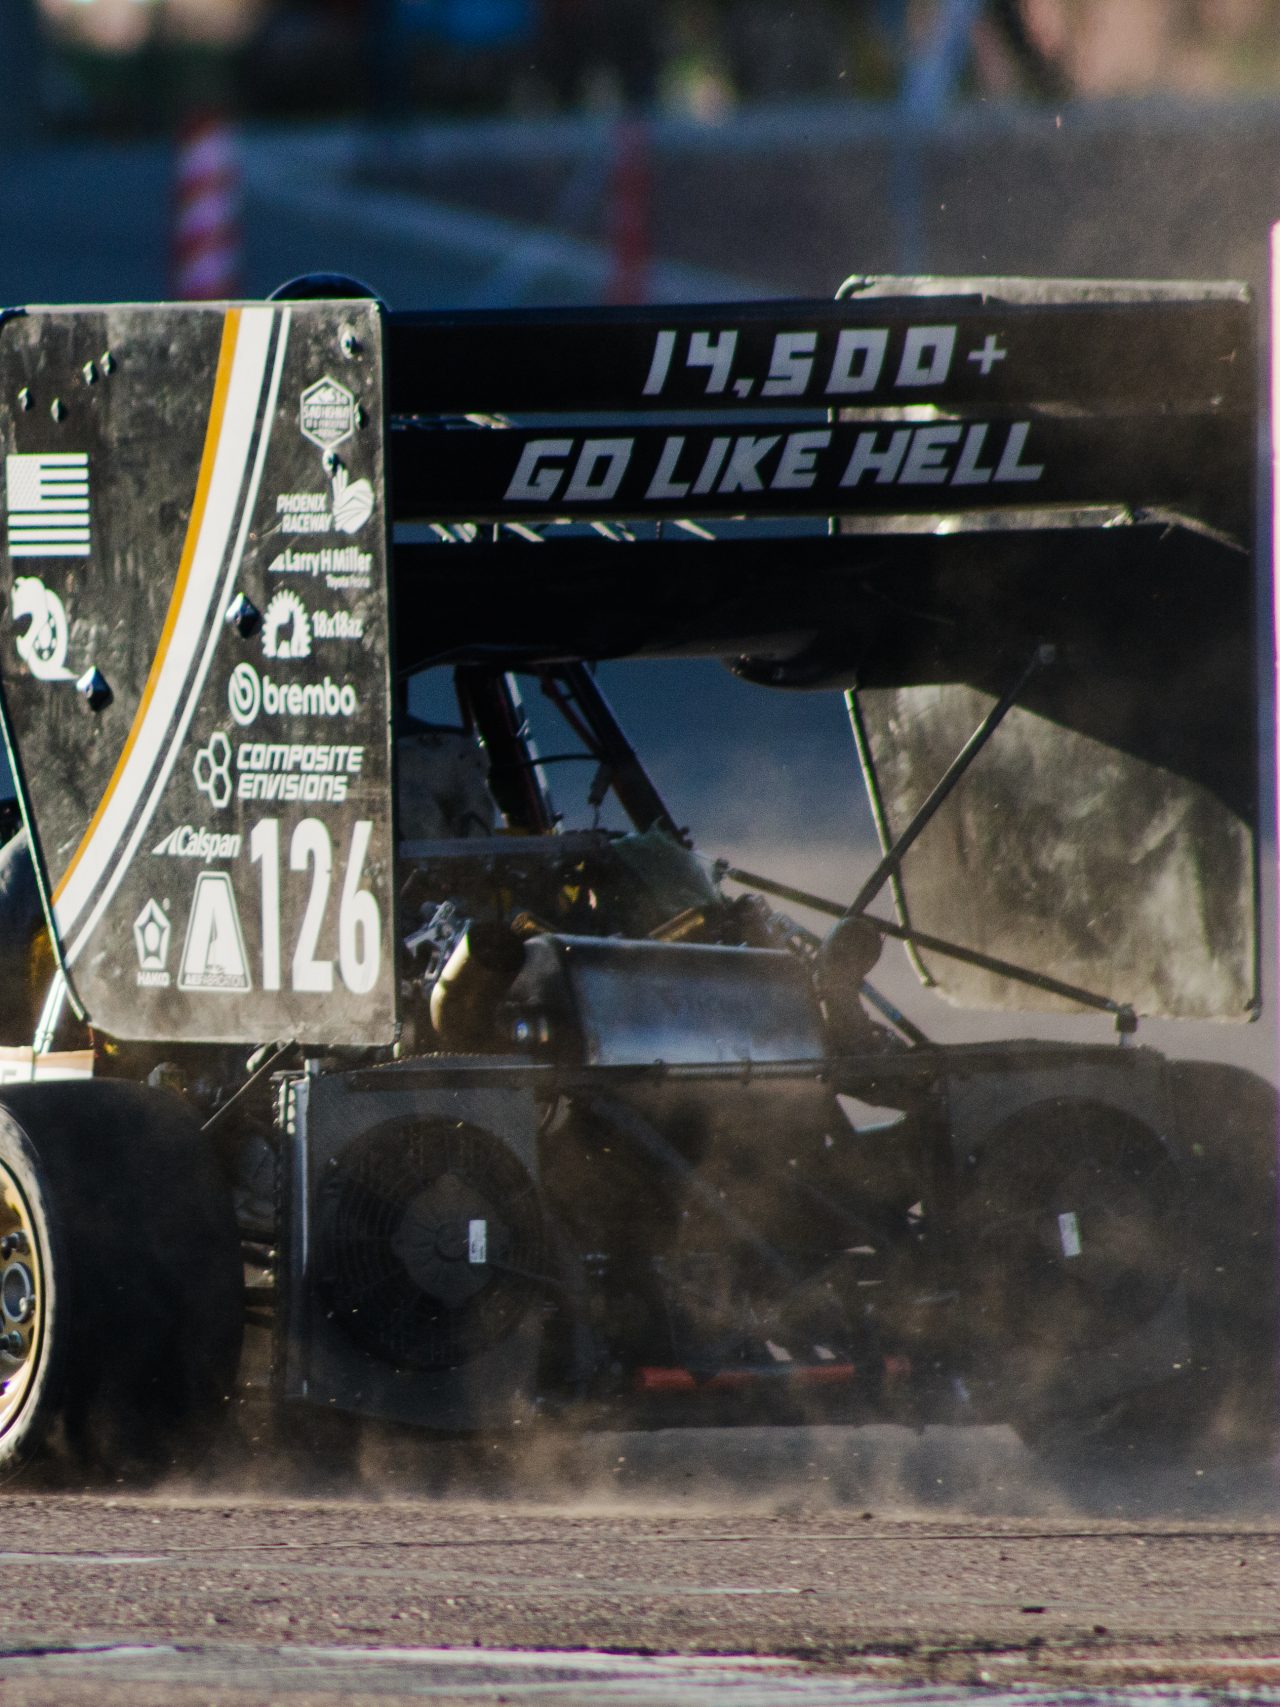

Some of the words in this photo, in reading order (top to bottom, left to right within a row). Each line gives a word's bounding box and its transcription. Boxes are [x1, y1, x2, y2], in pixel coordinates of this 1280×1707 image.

[502, 437, 635, 501] GO
[644, 429, 832, 499] LIKE
[838, 421, 1044, 487] HELL
[276, 493, 327, 513] PHOENIX
[282, 513, 333, 533] RACEWAY
[263, 677, 357, 716] brembo
[237, 743, 365, 772] COMPOSITE
[237, 773, 349, 802] ENVISIONS
[176, 825, 241, 863] Calspan
[250, 817, 382, 995] 126
